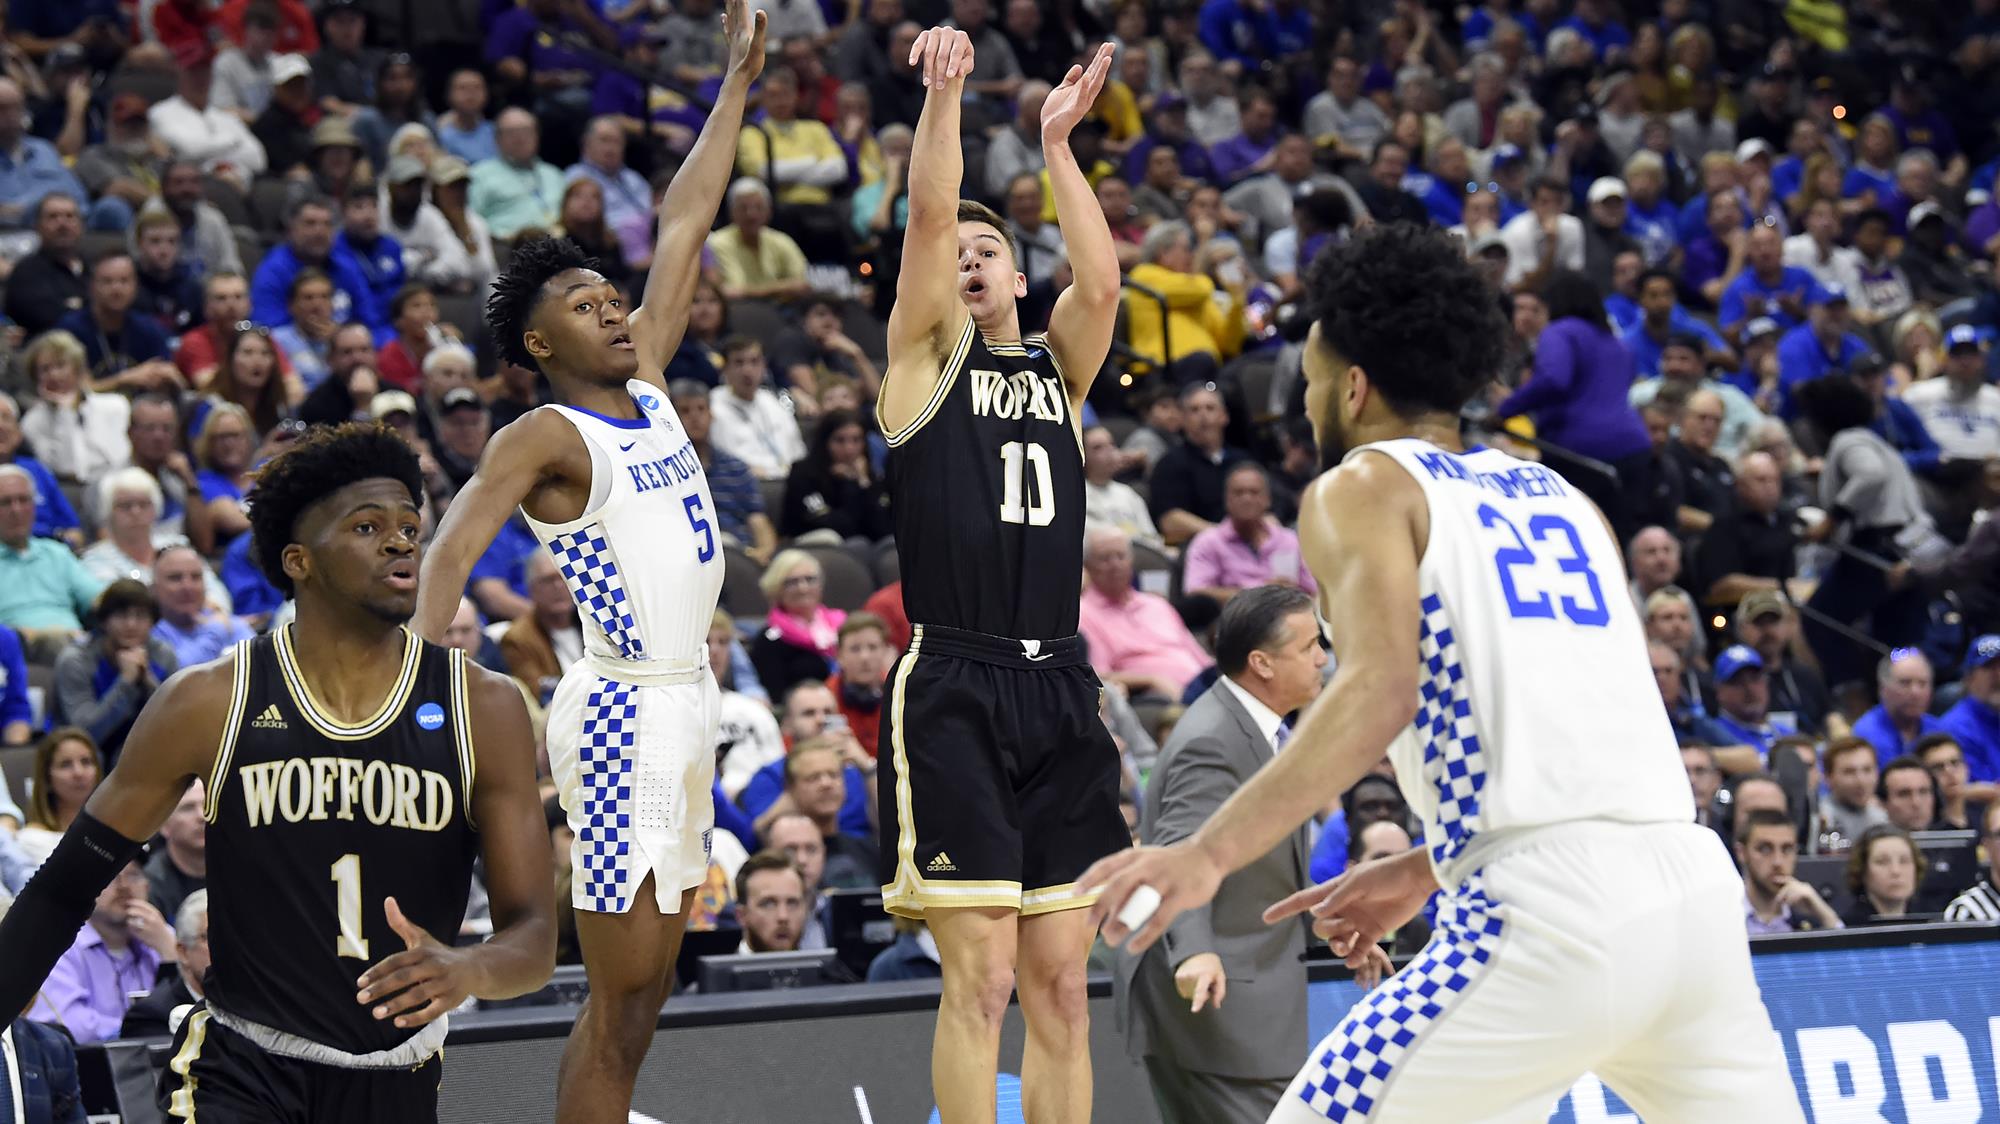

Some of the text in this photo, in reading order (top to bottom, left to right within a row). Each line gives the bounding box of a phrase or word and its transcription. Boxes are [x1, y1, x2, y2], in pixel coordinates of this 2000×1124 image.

[1000, 441, 1056, 527] 10
[682, 493, 715, 564] 5
[1476, 502, 1611, 628] 23
[251, 719, 288, 729] adidas
[239, 756, 454, 832] WOFFORD
[926, 864, 957, 872] adidas
[331, 853, 369, 961] 1
